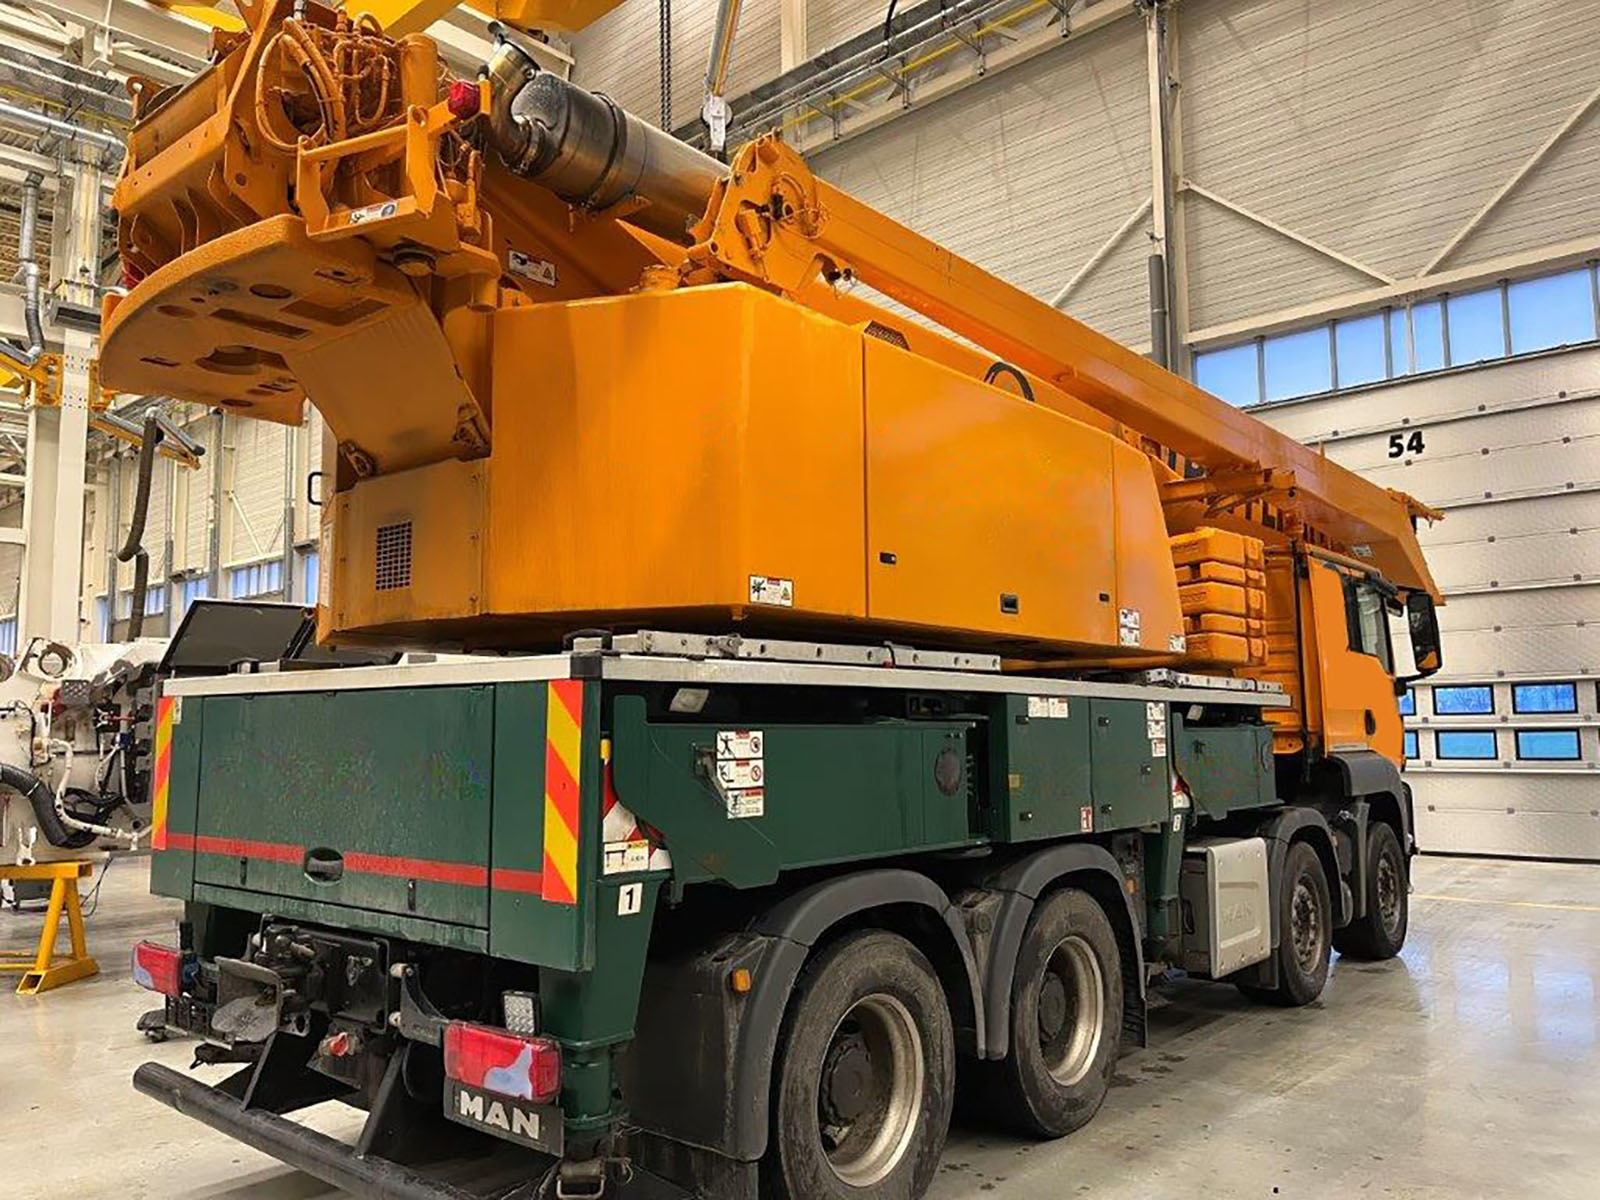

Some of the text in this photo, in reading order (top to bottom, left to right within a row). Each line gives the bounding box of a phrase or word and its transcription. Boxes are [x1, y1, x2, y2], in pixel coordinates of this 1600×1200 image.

[1388, 430, 1425, 458] 54
[625, 886, 634, 911] 1
[460, 1090, 539, 1140] MAN
